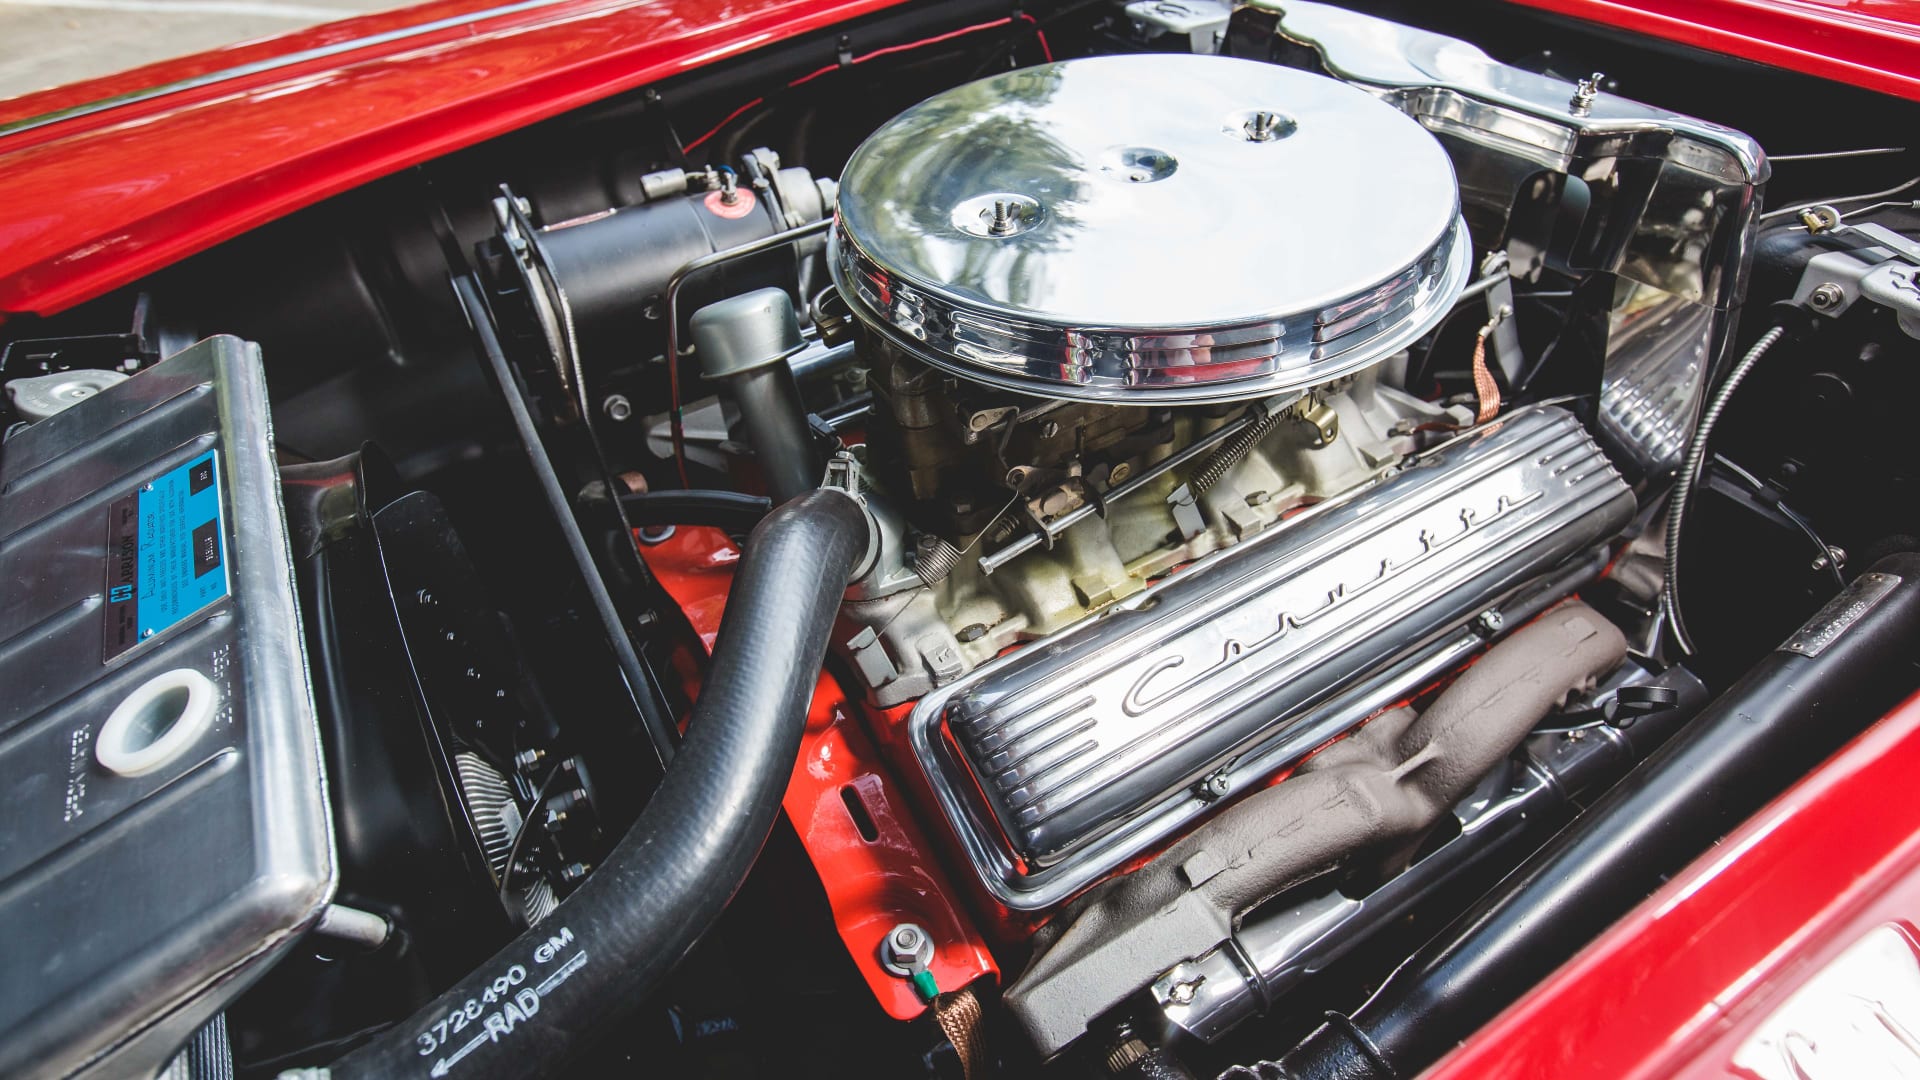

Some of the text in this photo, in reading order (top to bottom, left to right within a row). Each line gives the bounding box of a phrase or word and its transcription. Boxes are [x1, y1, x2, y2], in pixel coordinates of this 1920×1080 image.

[417, 926, 575, 1056] 3728490 GM
[483, 986, 540, 1043] RAD
